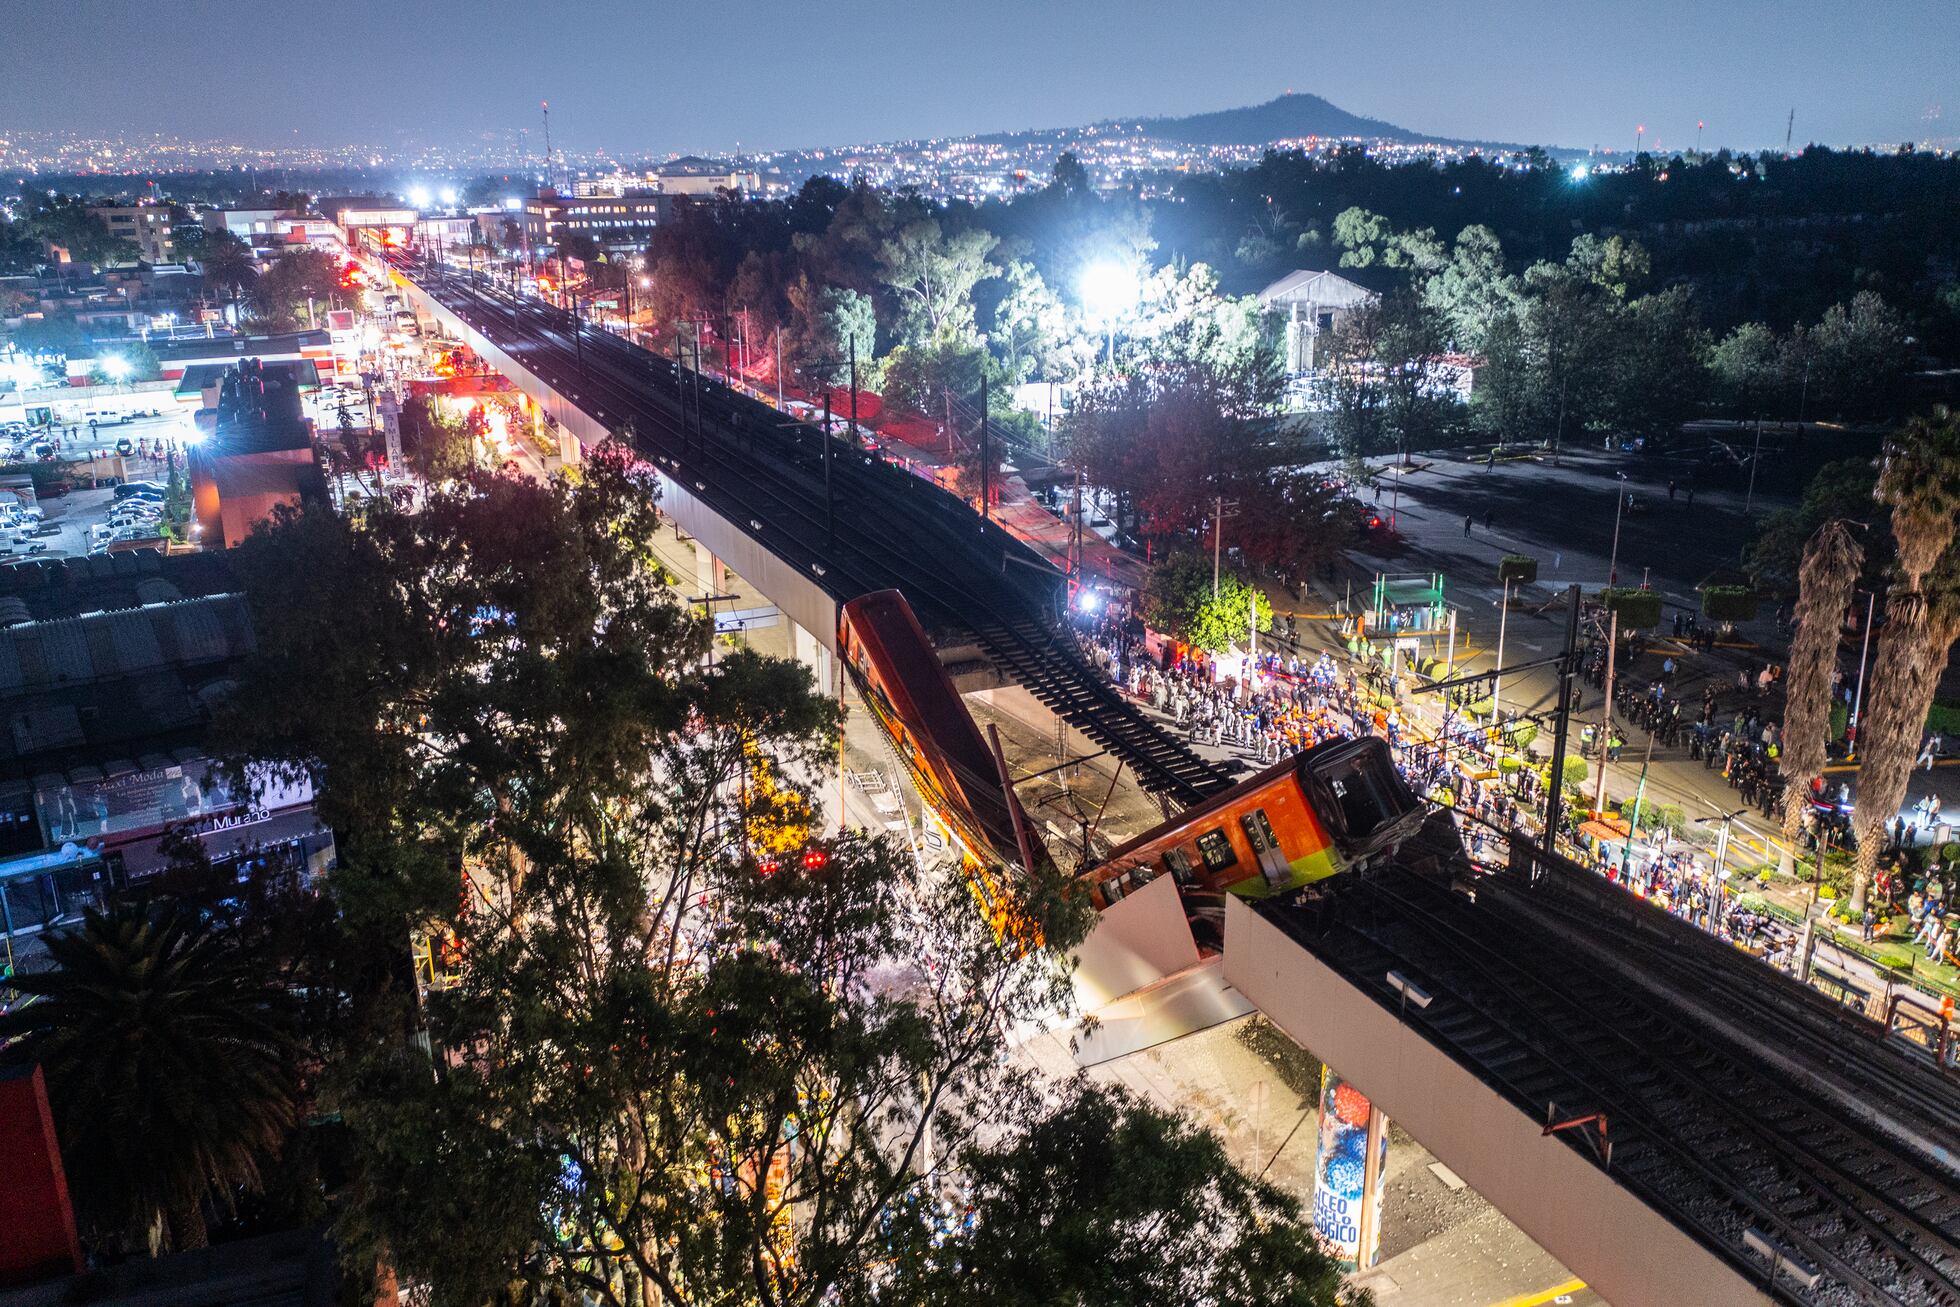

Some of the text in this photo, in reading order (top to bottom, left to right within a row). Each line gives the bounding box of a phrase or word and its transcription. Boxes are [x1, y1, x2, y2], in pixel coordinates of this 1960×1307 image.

[387, 414, 401, 475] SIMILARES
[129, 770, 164, 784] Moda
[213, 808, 270, 830] Murano
